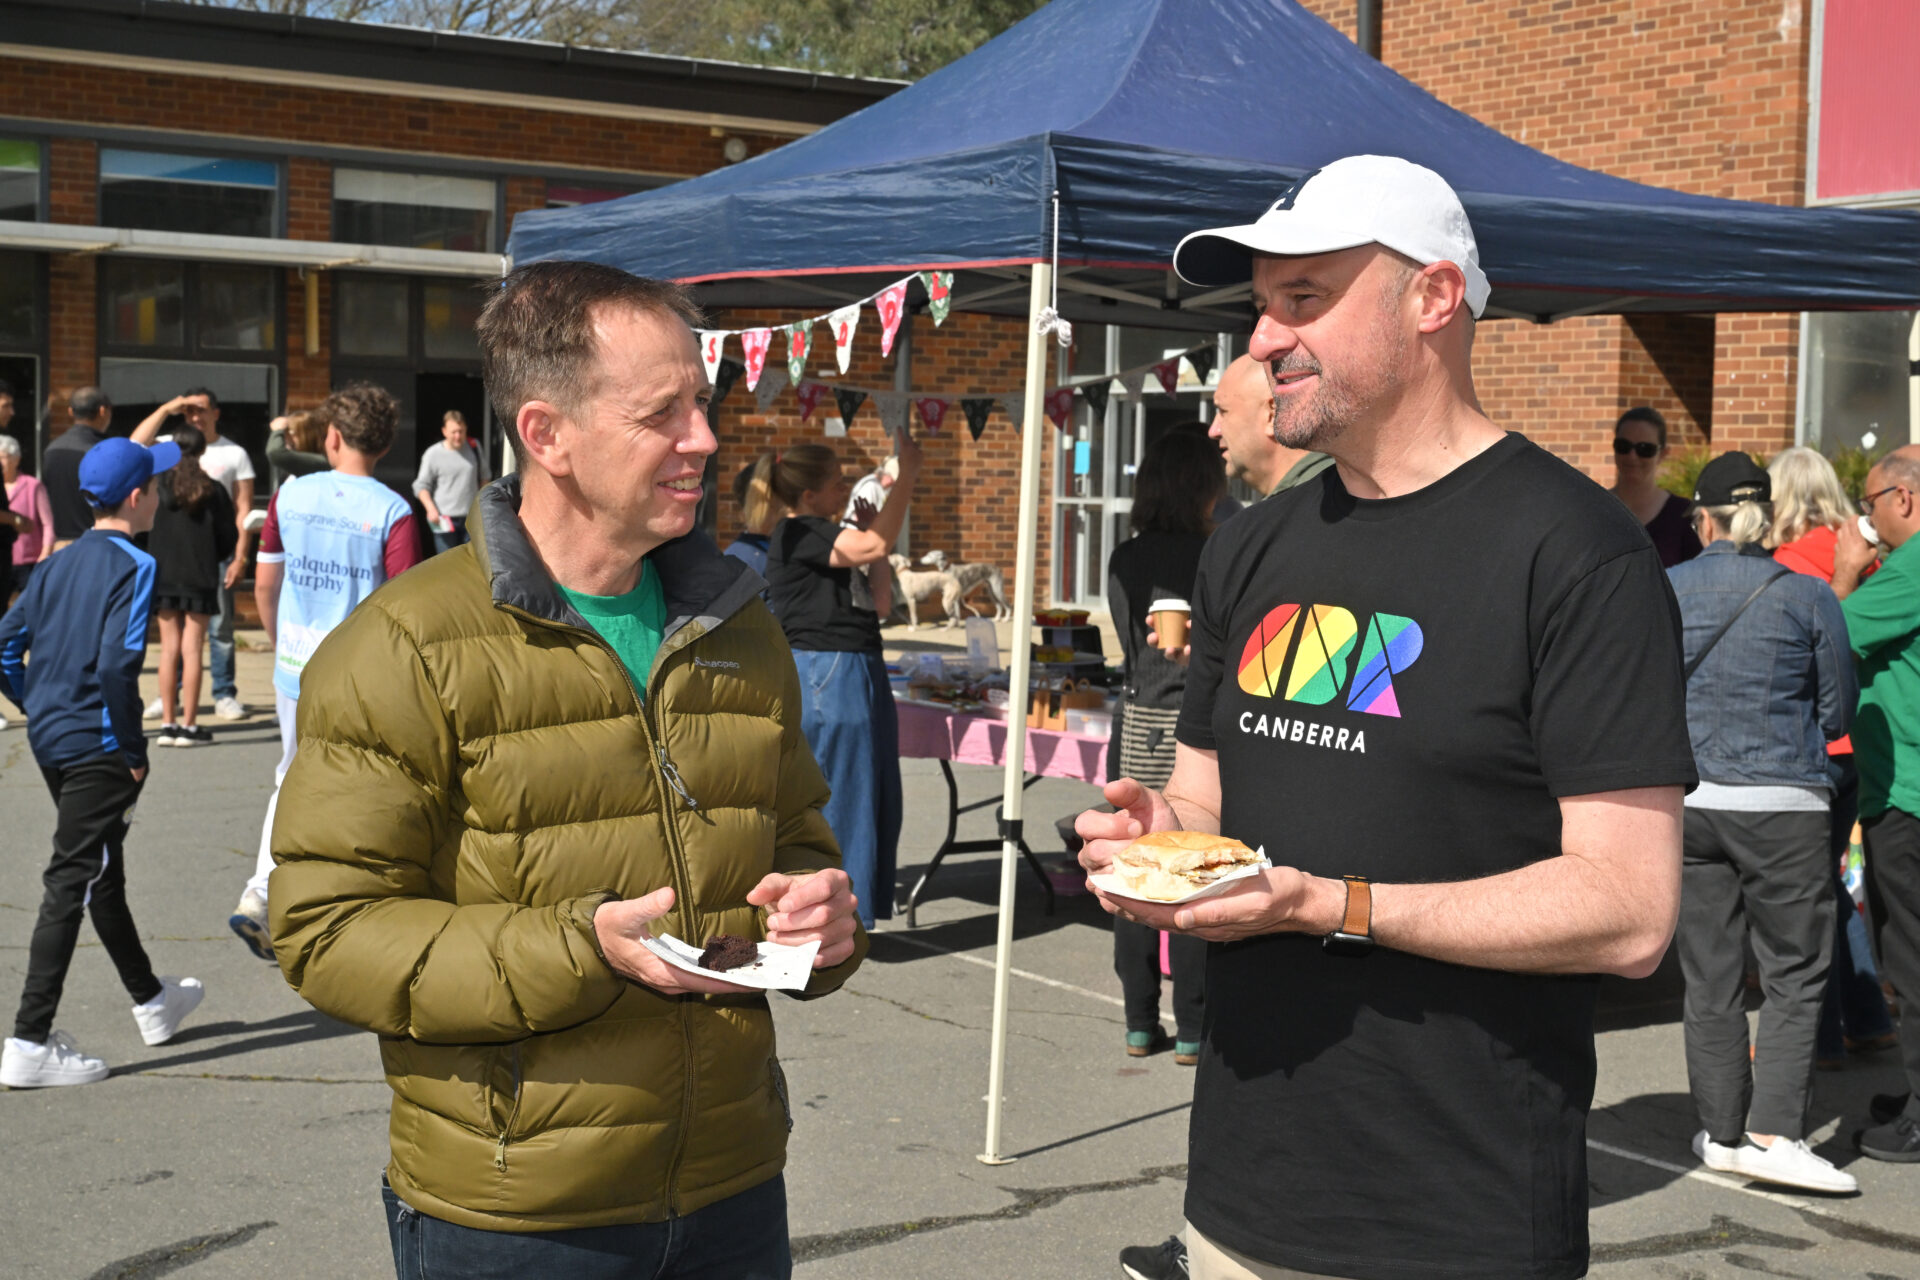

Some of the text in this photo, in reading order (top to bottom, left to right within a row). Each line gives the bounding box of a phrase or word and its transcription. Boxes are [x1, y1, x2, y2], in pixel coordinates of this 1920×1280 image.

[285, 510, 336, 526] Cosgrave
[286, 553, 371, 580] Colquhoun
[1239, 711, 1366, 753] CANBERRA
